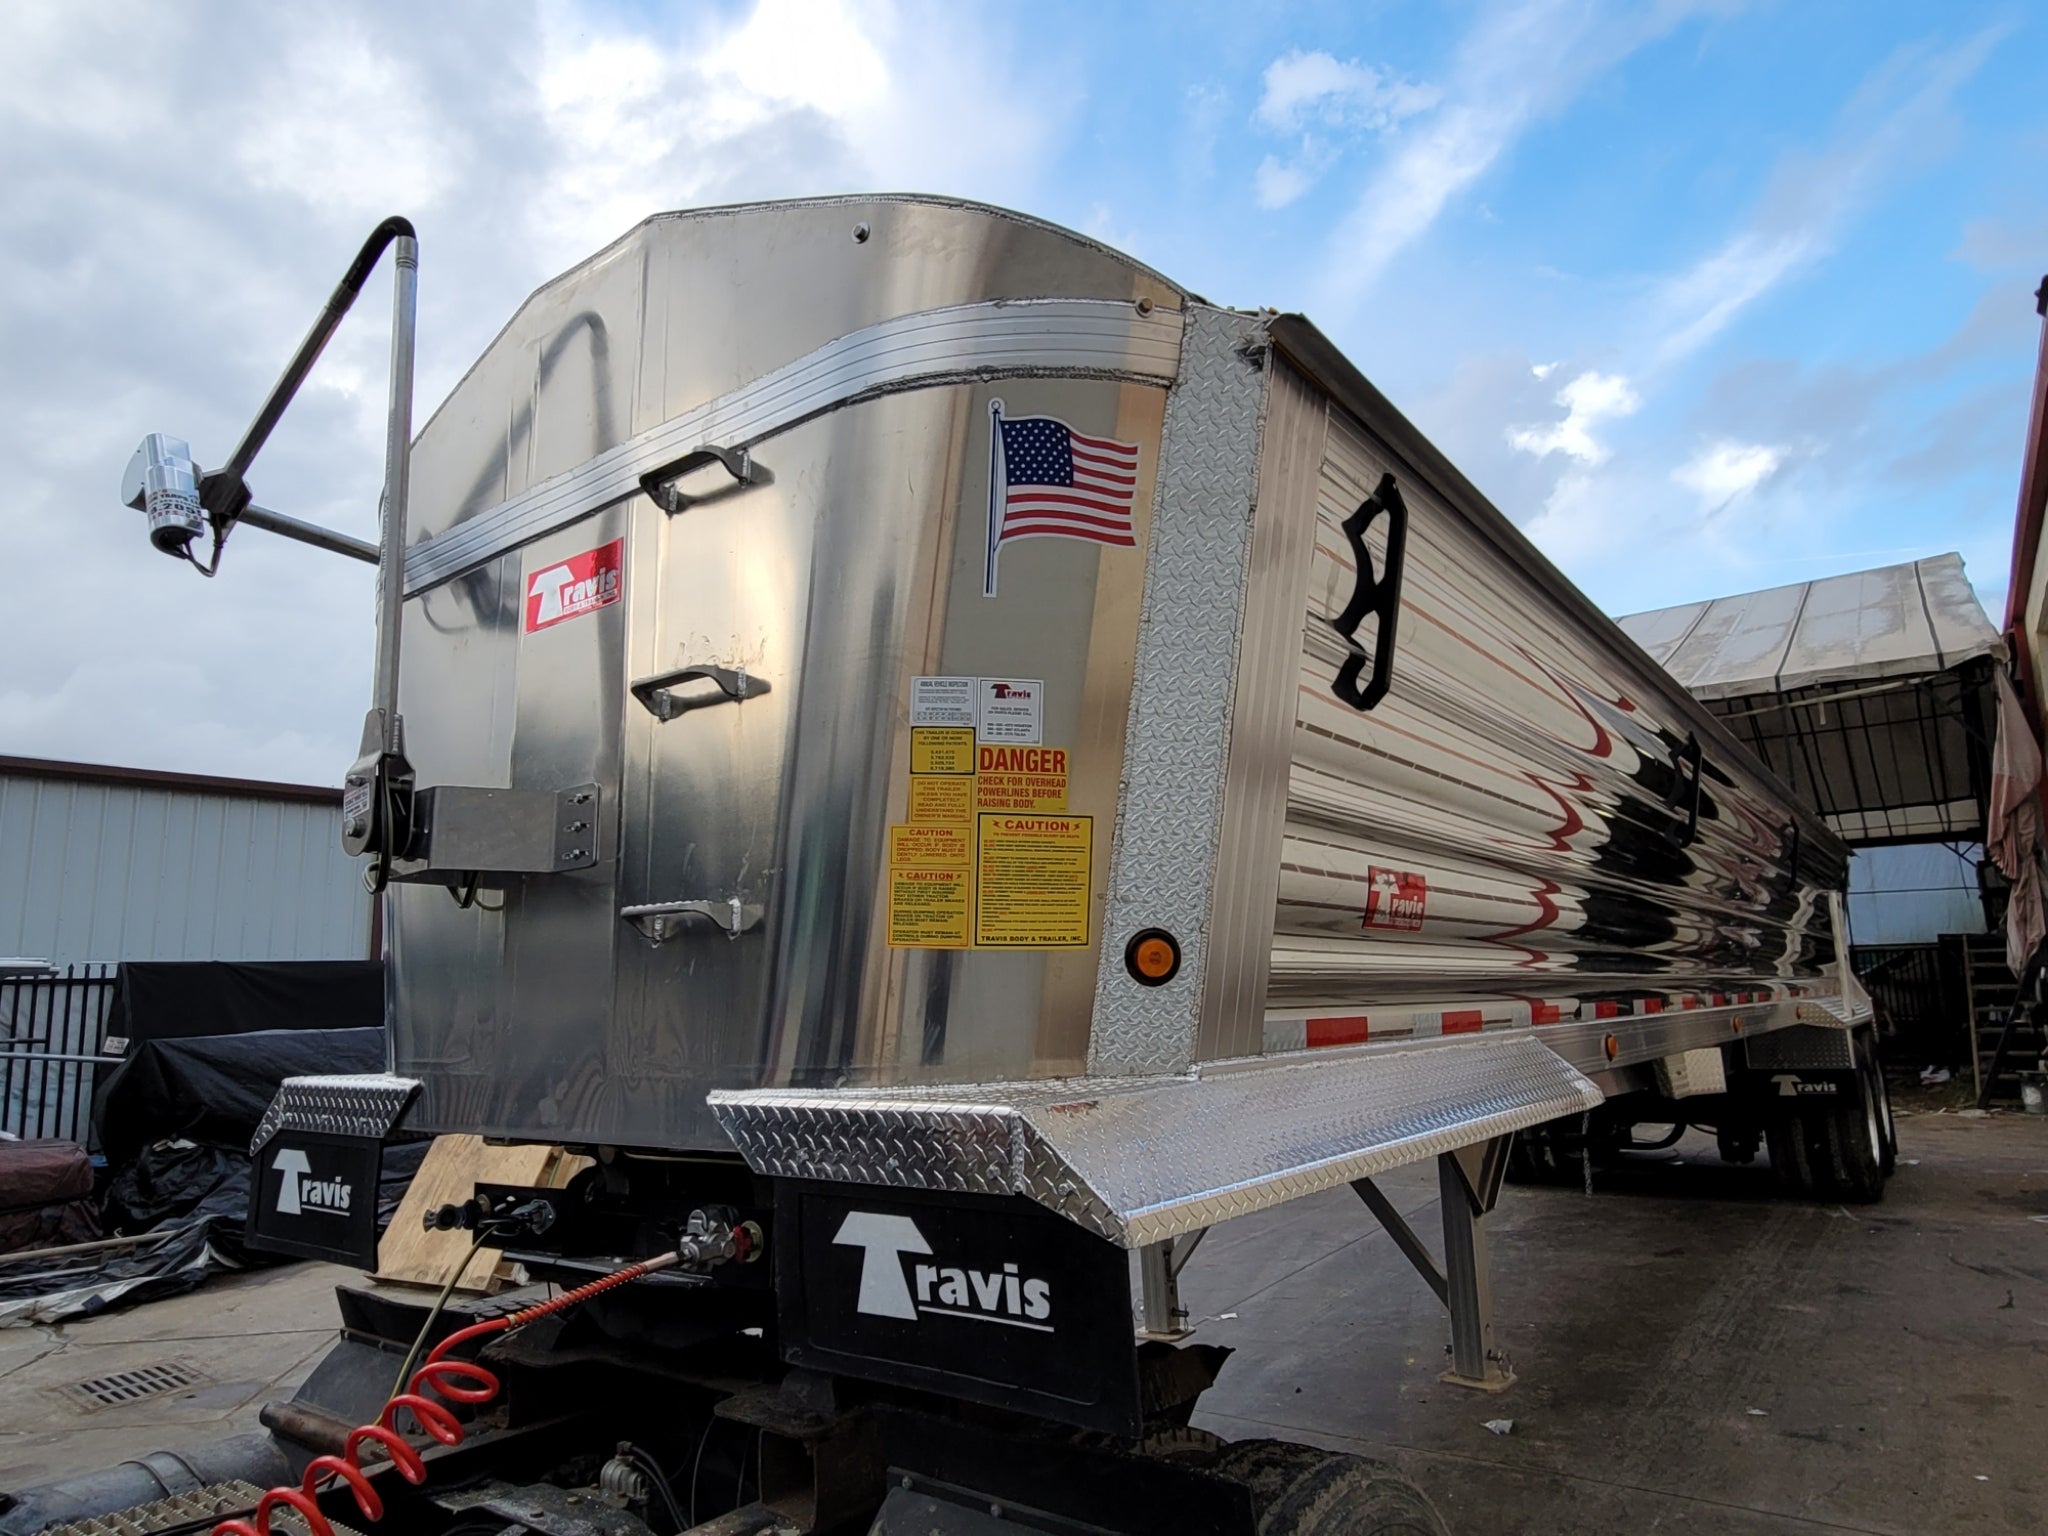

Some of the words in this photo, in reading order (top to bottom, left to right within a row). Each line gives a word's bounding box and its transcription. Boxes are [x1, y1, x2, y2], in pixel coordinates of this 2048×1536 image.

[528, 565, 618, 625] Travis
[991, 683, 1032, 699] Travis
[980, 747, 1066, 774] DANGER
[977, 776, 1005, 786] CHECK
[1007, 777, 1022, 786] FOR
[1025, 777, 1066, 788] OVERHEAD
[977, 787, 1030, 798] POWERLINES
[1032, 788, 1062, 799] BEFORE
[977, 798, 1011, 808] RAISING
[1013, 799, 1036, 809] BODY.
[909, 829, 953, 837] CAUTION
[1004, 819, 1070, 831] CAUTION
[906, 872, 954, 880] CAUTION
[1370, 873, 1424, 924] Travis
[1771, 1074, 1837, 1096] Travis
[271, 1148, 351, 1215] Travis
[832, 1210, 1051, 1321] Travis
